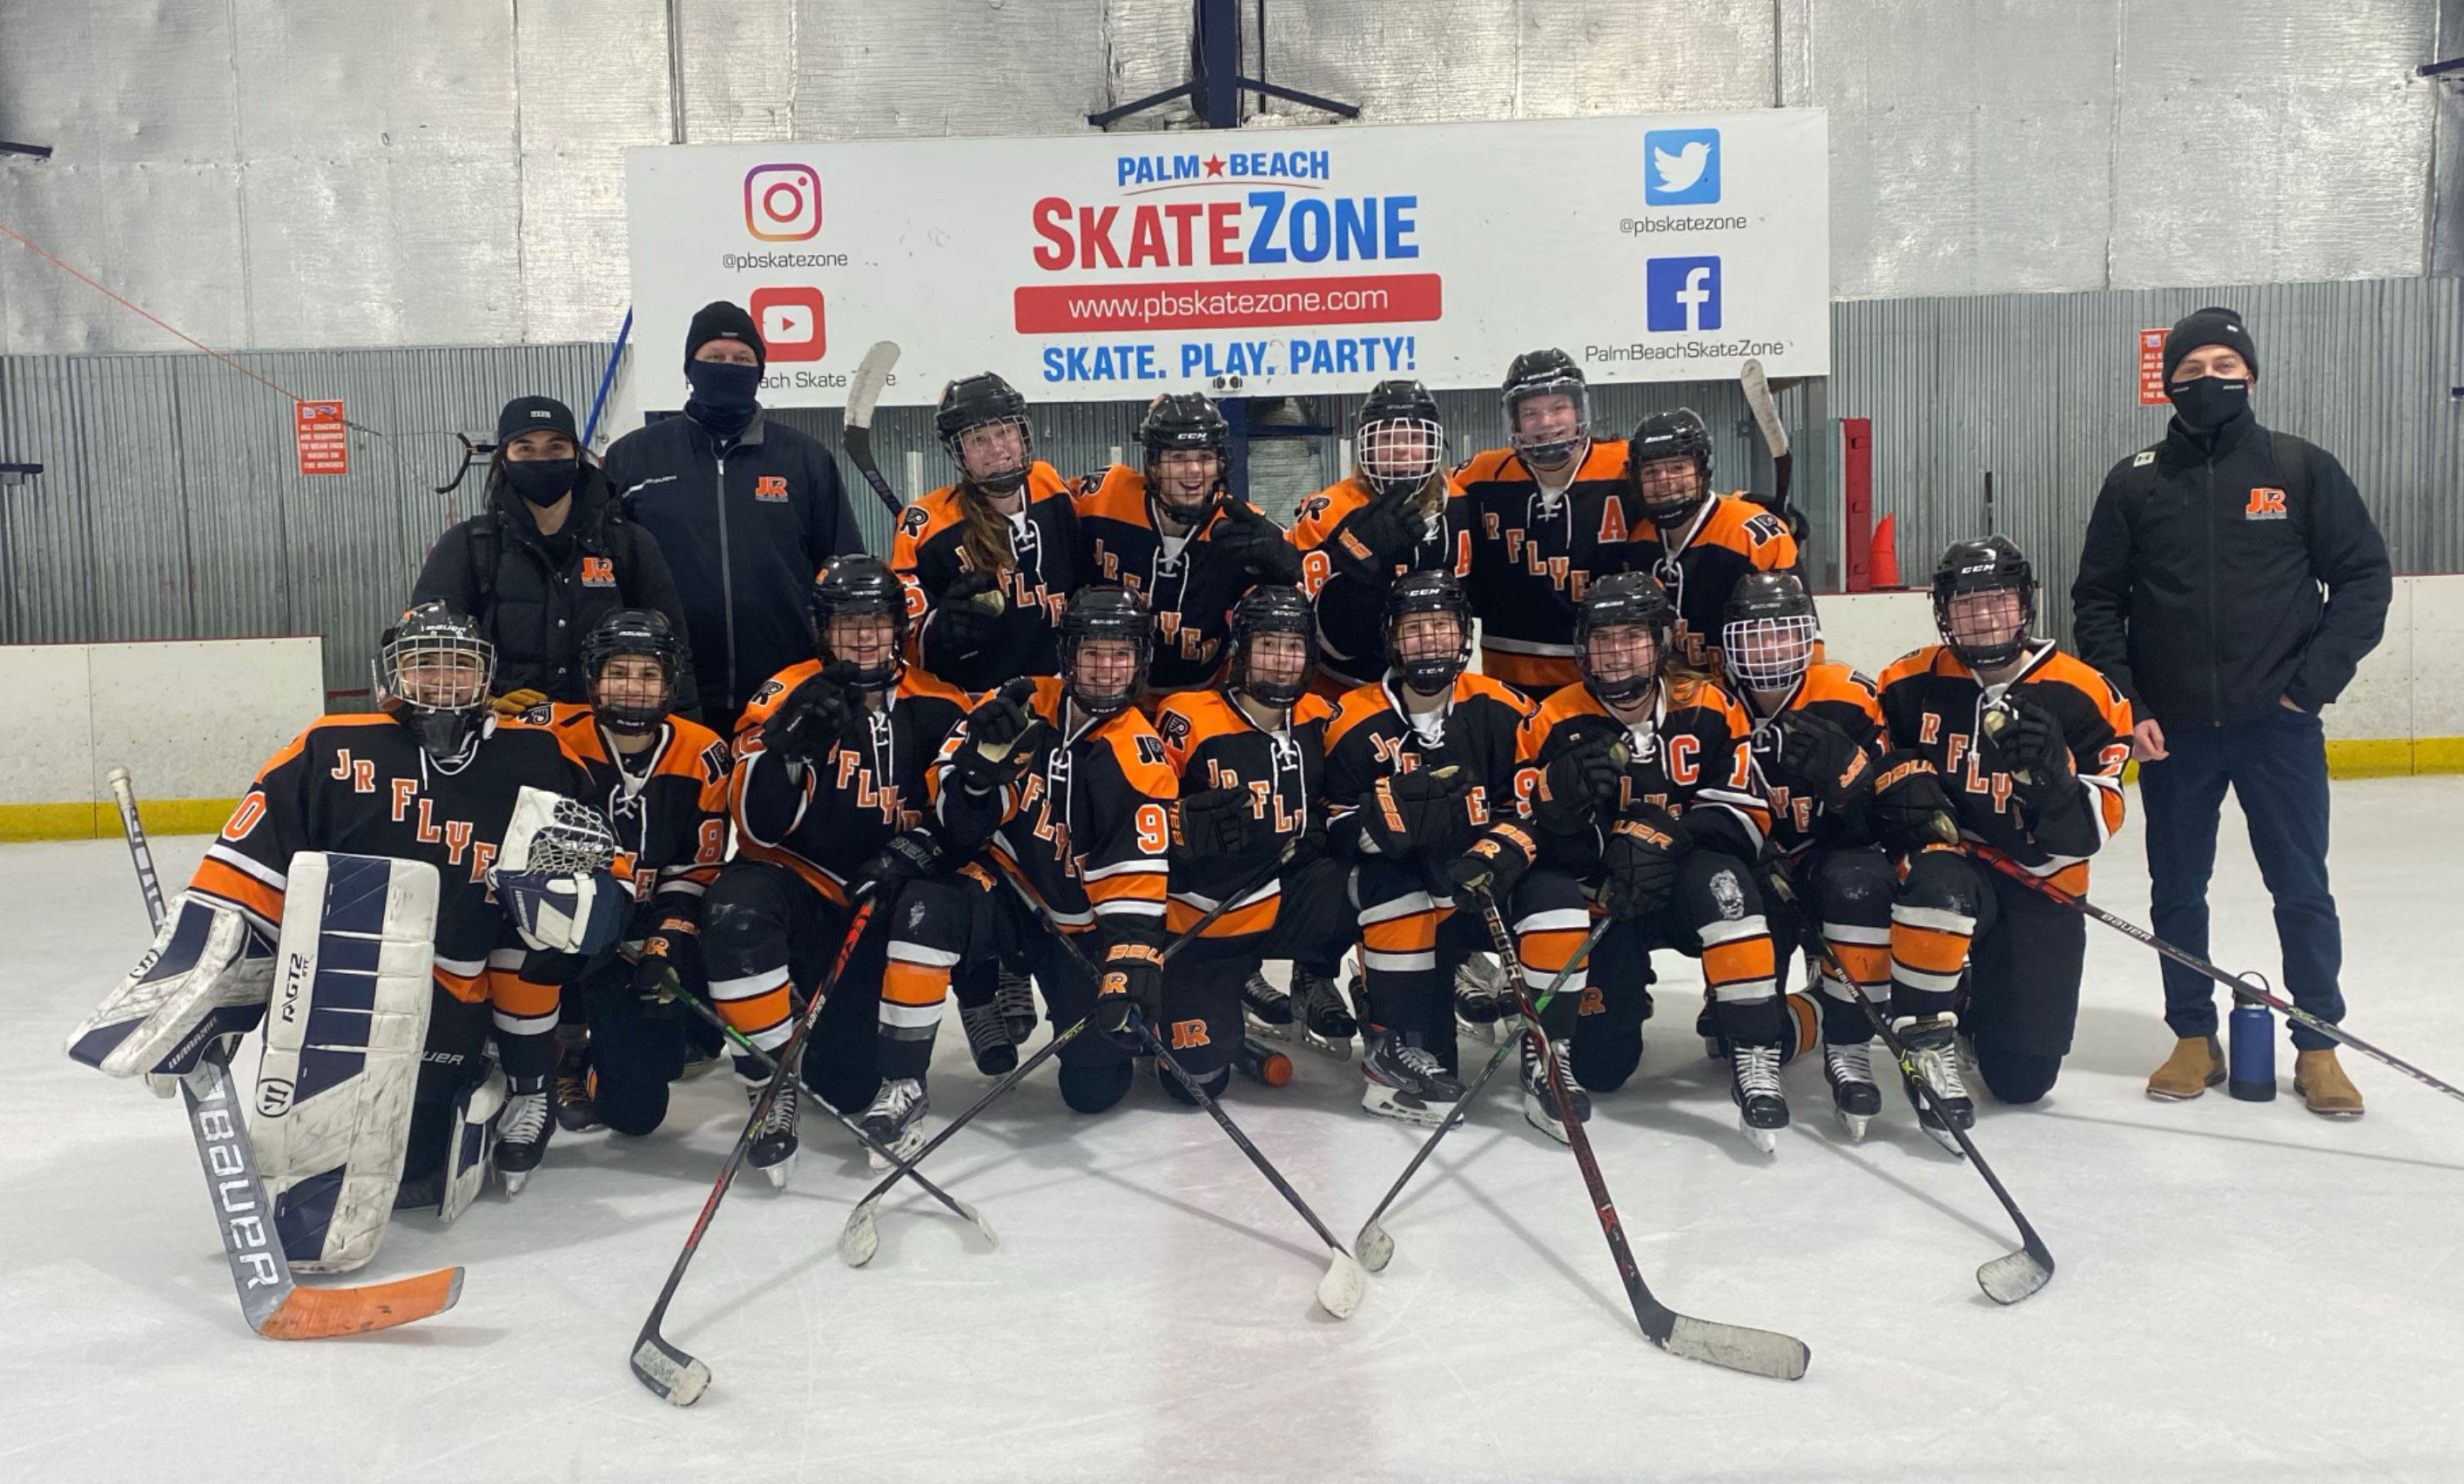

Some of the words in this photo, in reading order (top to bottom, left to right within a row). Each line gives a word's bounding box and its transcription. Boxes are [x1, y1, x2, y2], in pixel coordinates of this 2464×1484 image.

[1117, 155, 1199, 186] PALM
[1229, 151, 1329, 179] BEACH
[1033, 191, 1419, 271] SKATEZONE
[1619, 213, 1747, 238] @pbskatezone
[722, 252, 848, 272] @pbskatezone
[1068, 288, 1389, 323] www.pbskatezone.com
[1043, 345, 1166, 382] SKATE.
[1181, 341, 1275, 378] PLAY.
[1289, 337, 1415, 374] PARTY!
[1585, 339, 1785, 363] PalmBeachSkateZone
[760, 369, 791, 389] ach
[796, 371, 846, 388] Skate
[1177, 432, 1208, 440] CCM
[2246, 488, 2287, 513] JR
[1599, 495, 1629, 544] A
[1961, 563, 1996, 574] CCM
[1409, 588, 1441, 597] CCM
[1668, 734, 1700, 787] C
[221, 790, 267, 843] 0
[331, 749, 375, 793] JR
[392, 777, 500, 904] FLYE
[1135, 803, 1169, 855] 9
[694, 818, 725, 864] 8
[1611, 819, 1673, 851] UER
[1483, 906, 1523, 981] BAUER
[2101, 912, 2154, 943] BAUER
[1105, 943, 1166, 973] BAU
[1171, 1017, 1211, 1051] JR
[420, 1050, 466, 1066] UER
[199, 1108, 280, 1291] BAUER
